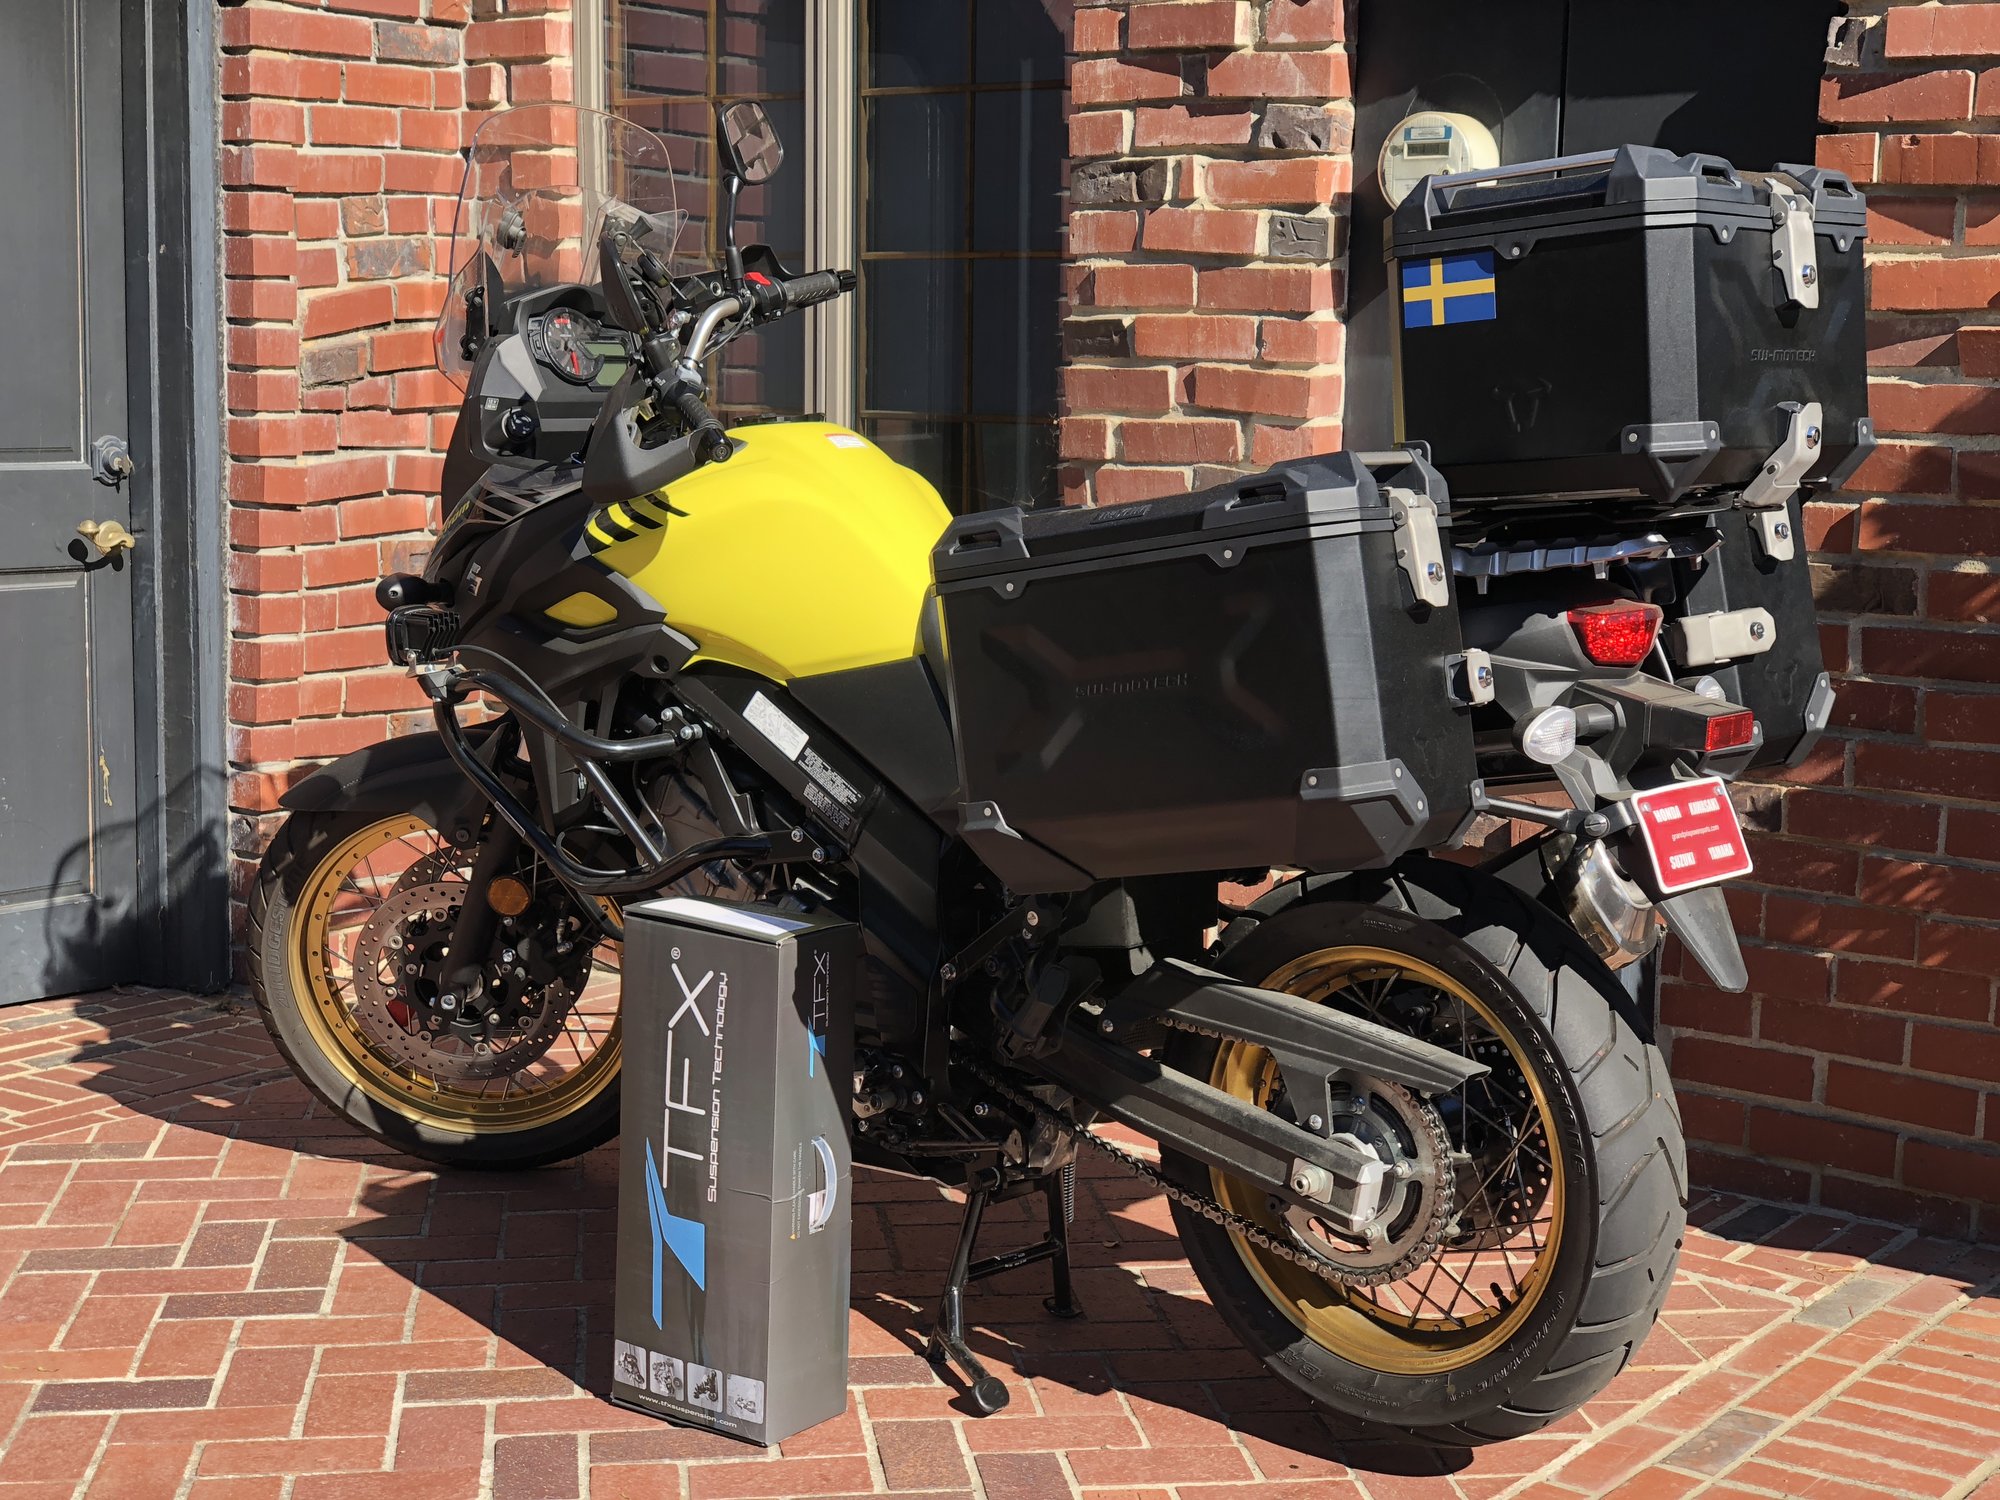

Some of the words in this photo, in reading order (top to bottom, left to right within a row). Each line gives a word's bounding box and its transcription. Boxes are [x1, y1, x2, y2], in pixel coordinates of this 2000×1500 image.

[1652, 805, 1683, 824] HONDA
[1687, 797, 1721, 816] KAWASAKI
[1668, 851, 1697, 870] SUZUKI
[1707, 842, 1736, 861] YAMAHA
[638, 1393, 738, 1429] www.tfxsuspension.com
